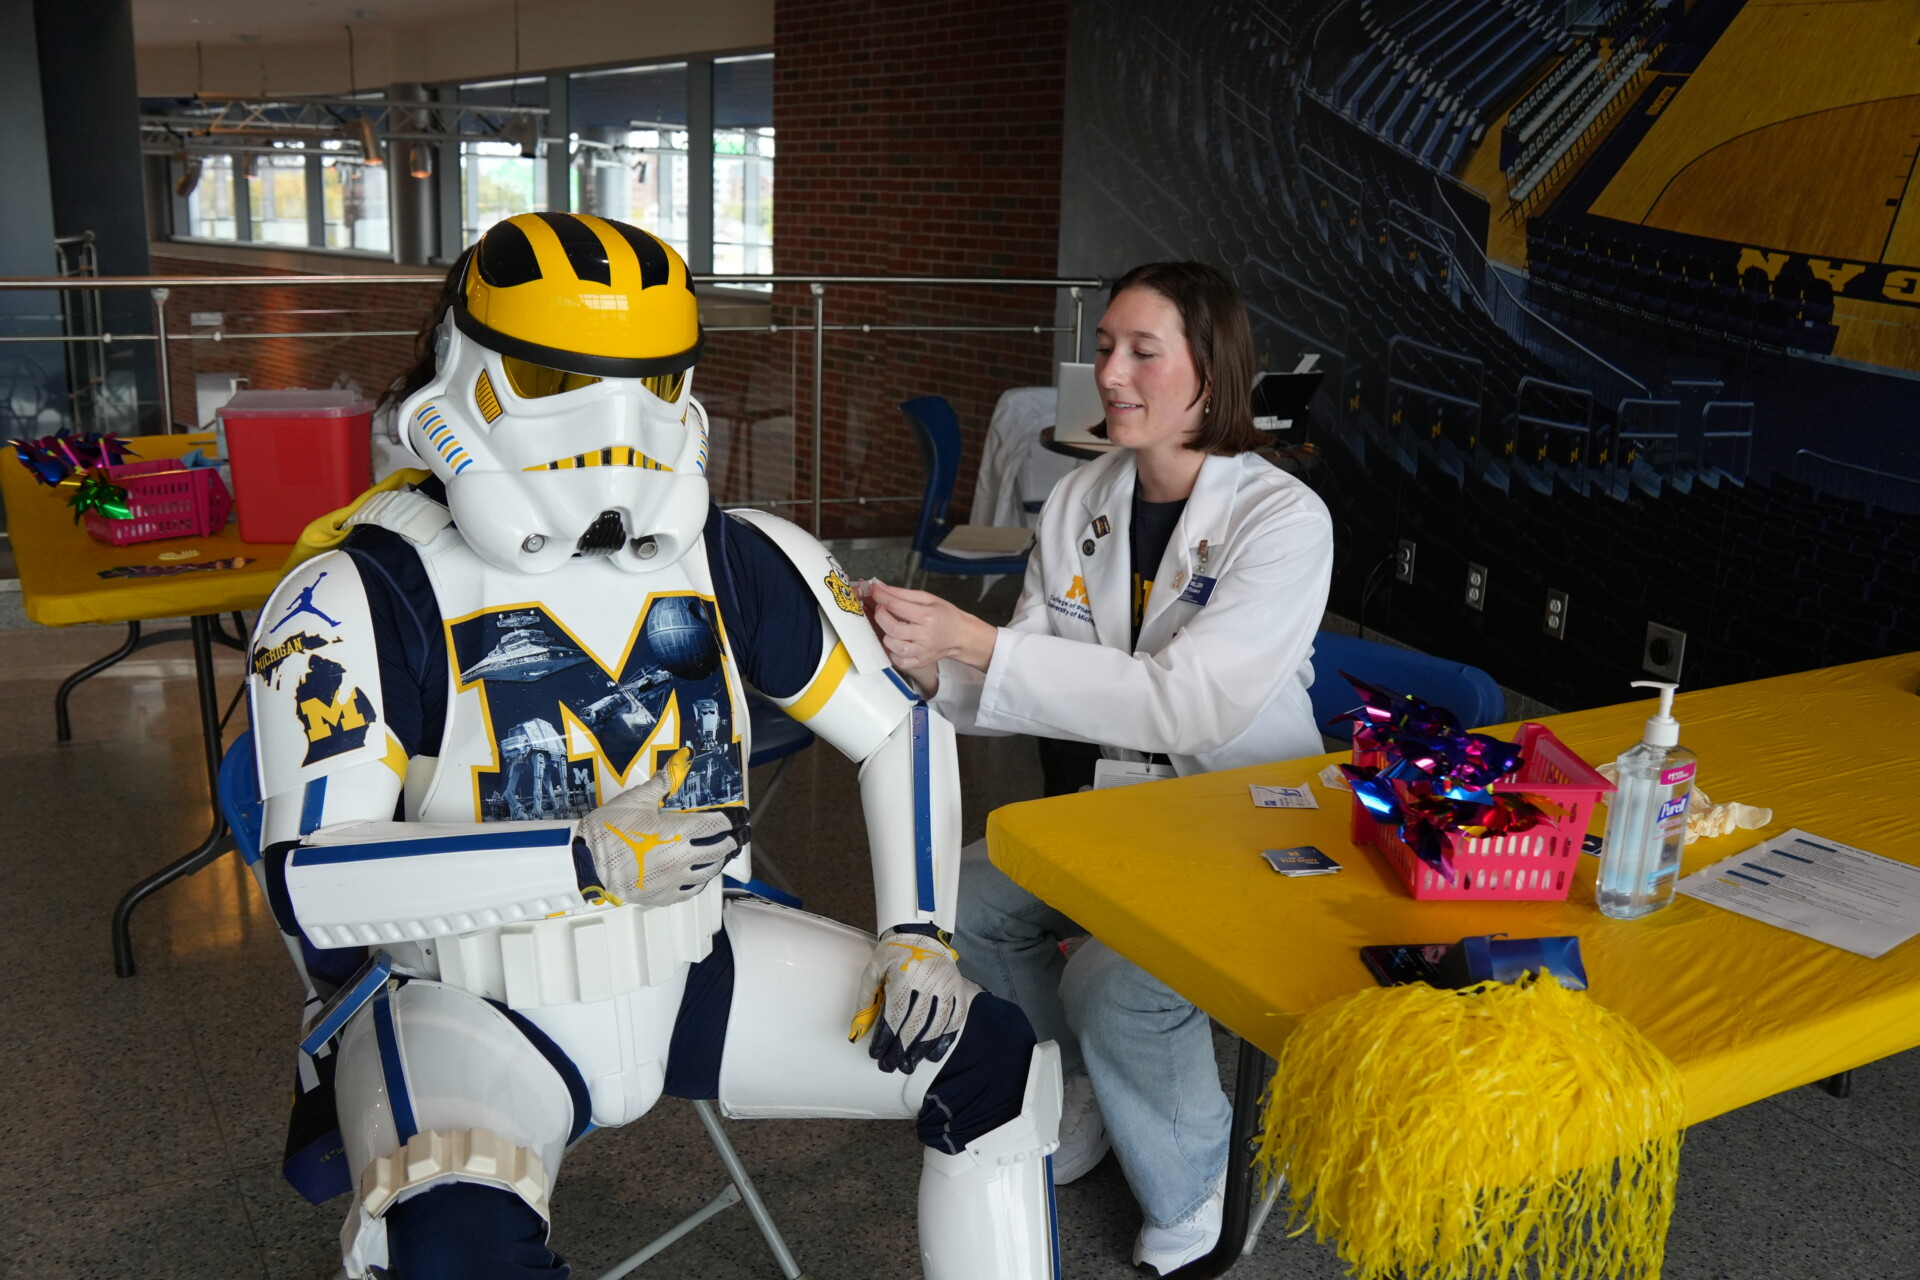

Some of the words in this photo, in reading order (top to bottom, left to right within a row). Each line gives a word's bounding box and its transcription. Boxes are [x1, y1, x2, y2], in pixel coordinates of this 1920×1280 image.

[1049, 594, 1069, 607] College
[254, 636, 304, 674] MICHIGAN
[300, 687, 366, 743] M
[572, 767, 590, 785] M
[1660, 798, 1687, 818] Purell
